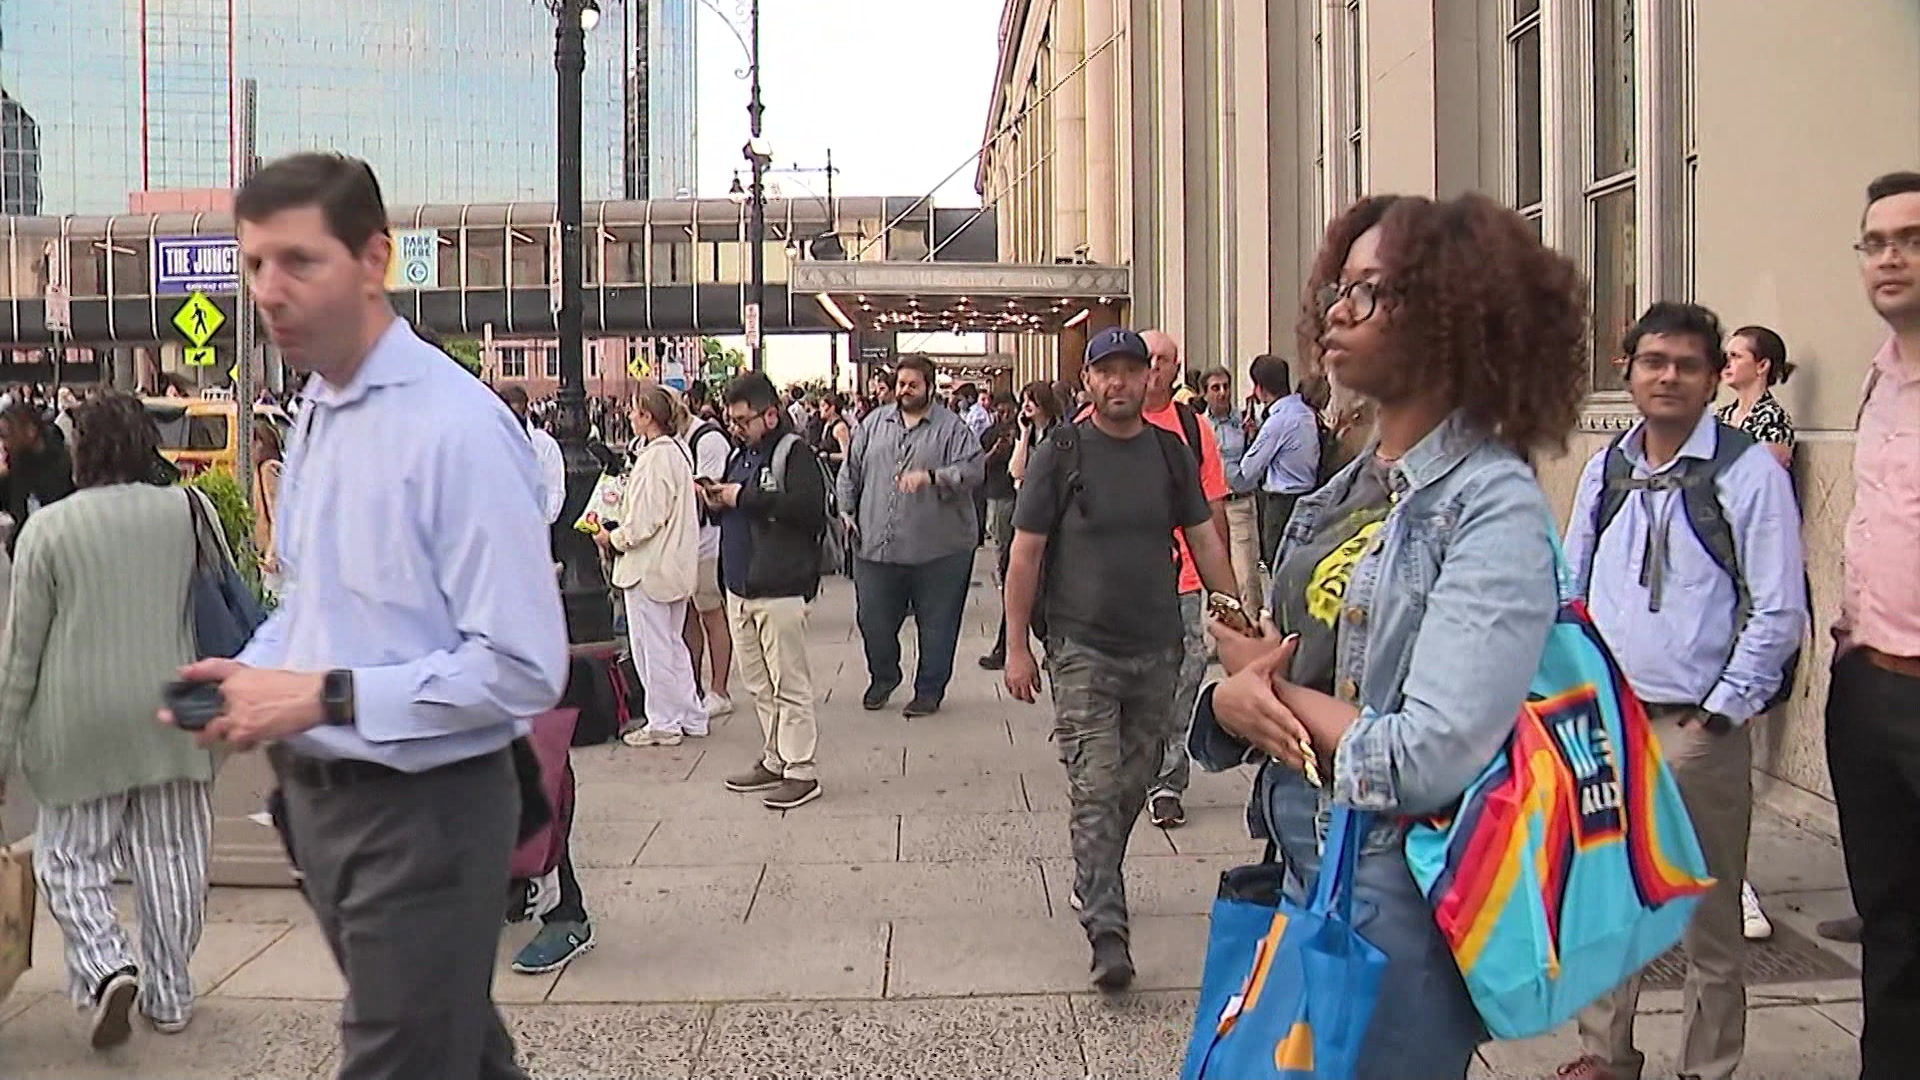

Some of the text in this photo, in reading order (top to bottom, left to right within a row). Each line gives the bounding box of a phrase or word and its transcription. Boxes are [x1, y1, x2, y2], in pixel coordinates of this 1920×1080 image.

[402, 236, 431, 247] PARK
[165, 246, 239, 274] THE JUNCT
